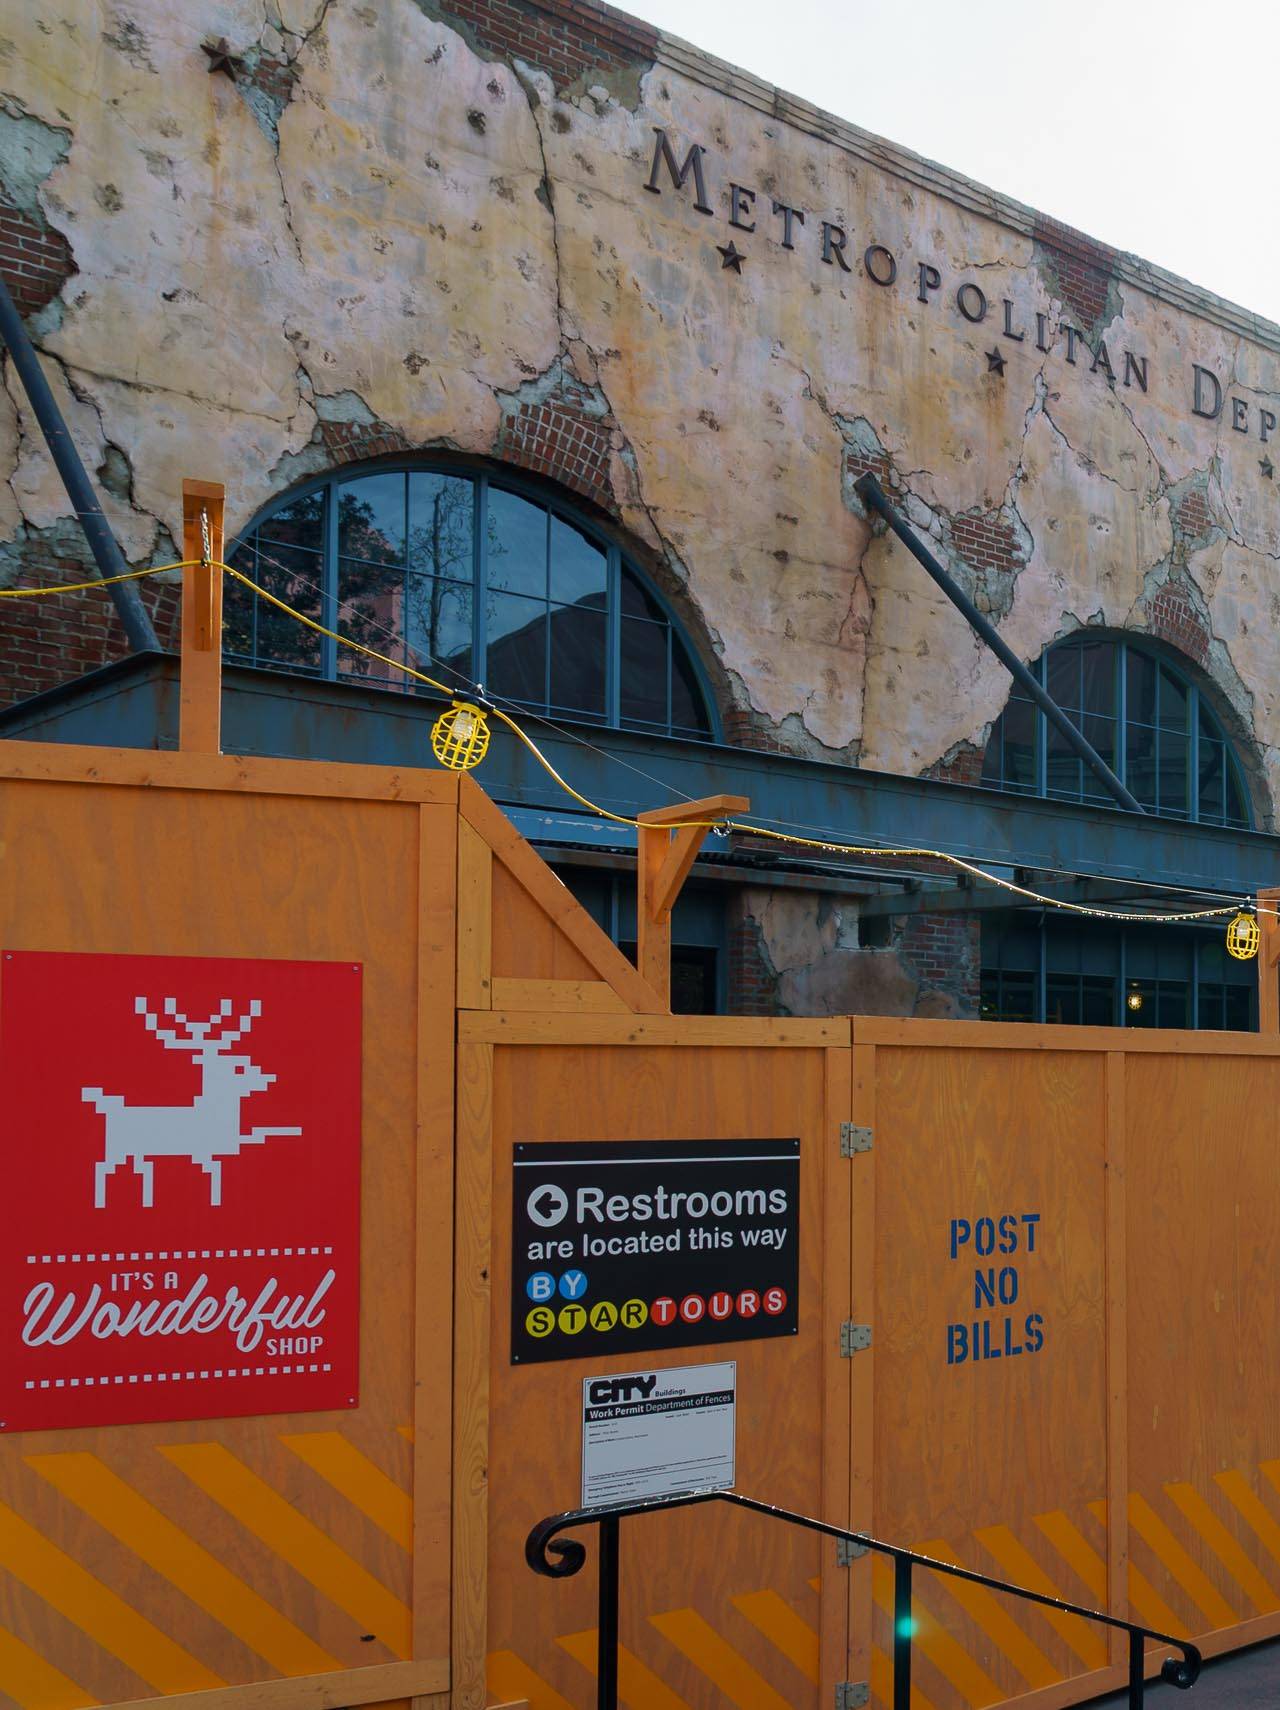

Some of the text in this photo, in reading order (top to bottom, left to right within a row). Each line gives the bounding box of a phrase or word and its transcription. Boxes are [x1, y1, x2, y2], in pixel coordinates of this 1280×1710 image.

[643, 127, 1148, 393] METROPOLITAN
[577, 1185, 788, 1224] Restrooms
[528, 1227, 787, 1260] are located this way
[950, 1213, 1041, 1260] POST
[111, 1271, 179, 1292] IT'S A
[530, 1272, 584, 1300] BY
[975, 1266, 1019, 1309] NO
[22, 1269, 336, 1353] Wonderful
[266, 1336, 323, 1355] SHOP
[947, 1313, 1044, 1365] BILLS
[589, 1374, 686, 1405] CITY Buildings
[589, 1409, 613, 1419] Work
[615, 1406, 644, 1416] Permit
[645, 1399, 694, 1413] Department
[705, 1394, 731, 1404] Fences
